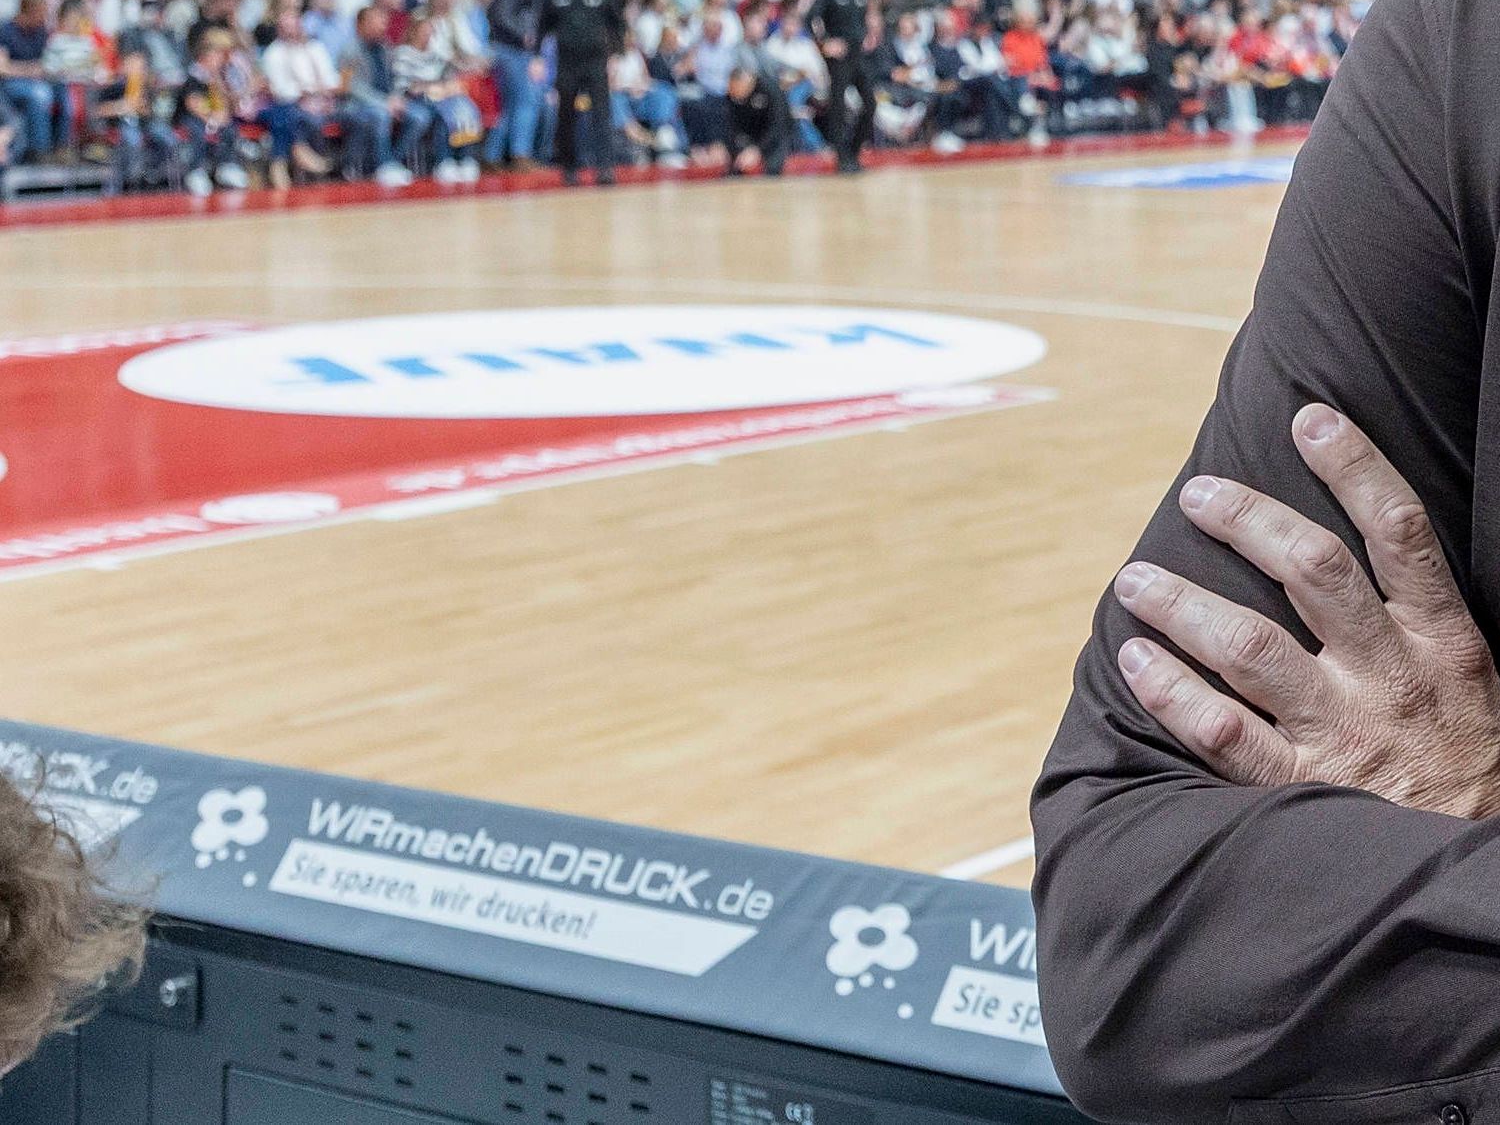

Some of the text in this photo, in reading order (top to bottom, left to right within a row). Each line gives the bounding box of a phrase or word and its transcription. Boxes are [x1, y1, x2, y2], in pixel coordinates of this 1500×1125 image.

[293, 850, 599, 941] Sie sparen, wir drucken!
[307, 797, 774, 921] WIRmachenDRUCK.de
[970, 917, 1037, 972] WI
[953, 982, 1000, 1020] Sie
